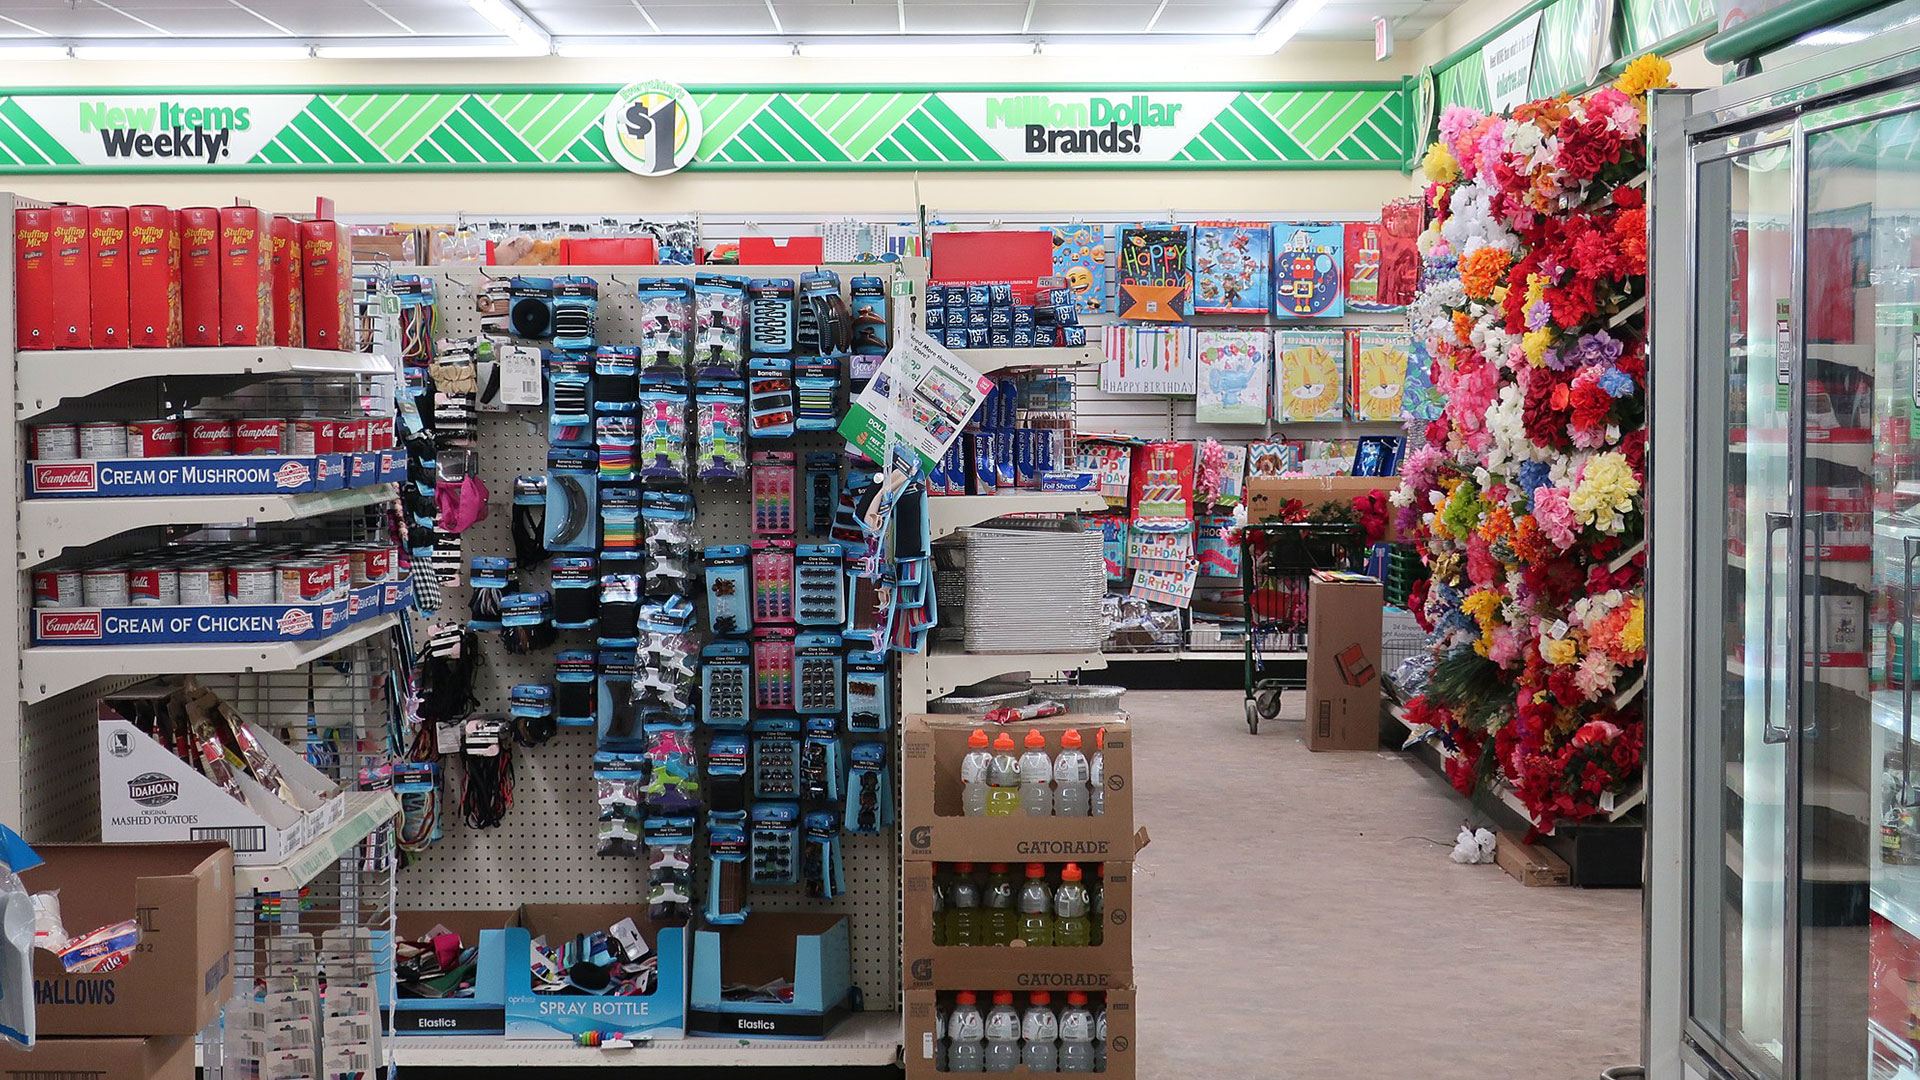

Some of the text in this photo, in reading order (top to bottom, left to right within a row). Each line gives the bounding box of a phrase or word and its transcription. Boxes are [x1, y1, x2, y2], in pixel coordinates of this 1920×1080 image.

[80, 102, 249, 132] New Items
[986, 95, 1182, 128] Million Dollar
[625, 98, 679, 173] $1
[1025, 123, 1141, 154] Brands!
[101, 126, 230, 164] Weekly!
[1124, 244, 1187, 276] Happy
[926, 294, 940, 303] 25
[948, 294, 962, 304] 25
[949, 314, 963, 324] 25
[993, 313, 1007, 323] 25
[1015, 313, 1029, 322] 25
[947, 336, 961, 346] 25
[993, 334, 1007, 344] 25
[1014, 334, 1028, 344] 25
[1036, 333, 1050, 343] 25
[923, 343, 938, 357] More
[937, 354, 950, 367] than
[949, 363, 969, 381] What's
[1110, 380, 1194, 393] HAPPY BIRTHDAY
[1076, 455, 1127, 474] HAPPY
[40, 469, 89, 486] Campbell's
[101, 467, 155, 486] CREAM
[159, 469, 179, 484] OF
[182, 466, 270, 484] MUSHROOM
[1058, 482, 1077, 490] Sheets
[1131, 544, 1184, 560] BIRTHDAY
[1137, 574, 1190, 598] BIRTHDAY
[46, 618, 97, 634] Campbell's
[105, 616, 164, 633] CREAM
[170, 617, 193, 633] OF
[197, 615, 273, 632] CHICKEN
[131, 782, 177, 798] IDAHOAN
[111, 815, 198, 826] MASHED POTATOES
[1017, 840, 1109, 855] GATORADE
[1018, 972, 1110, 987] GATORADE
[539, 1001, 649, 1017] SPRAY BOTTLE
[418, 1018, 457, 1029] Elastics
[738, 1019, 775, 1031] Elastics
